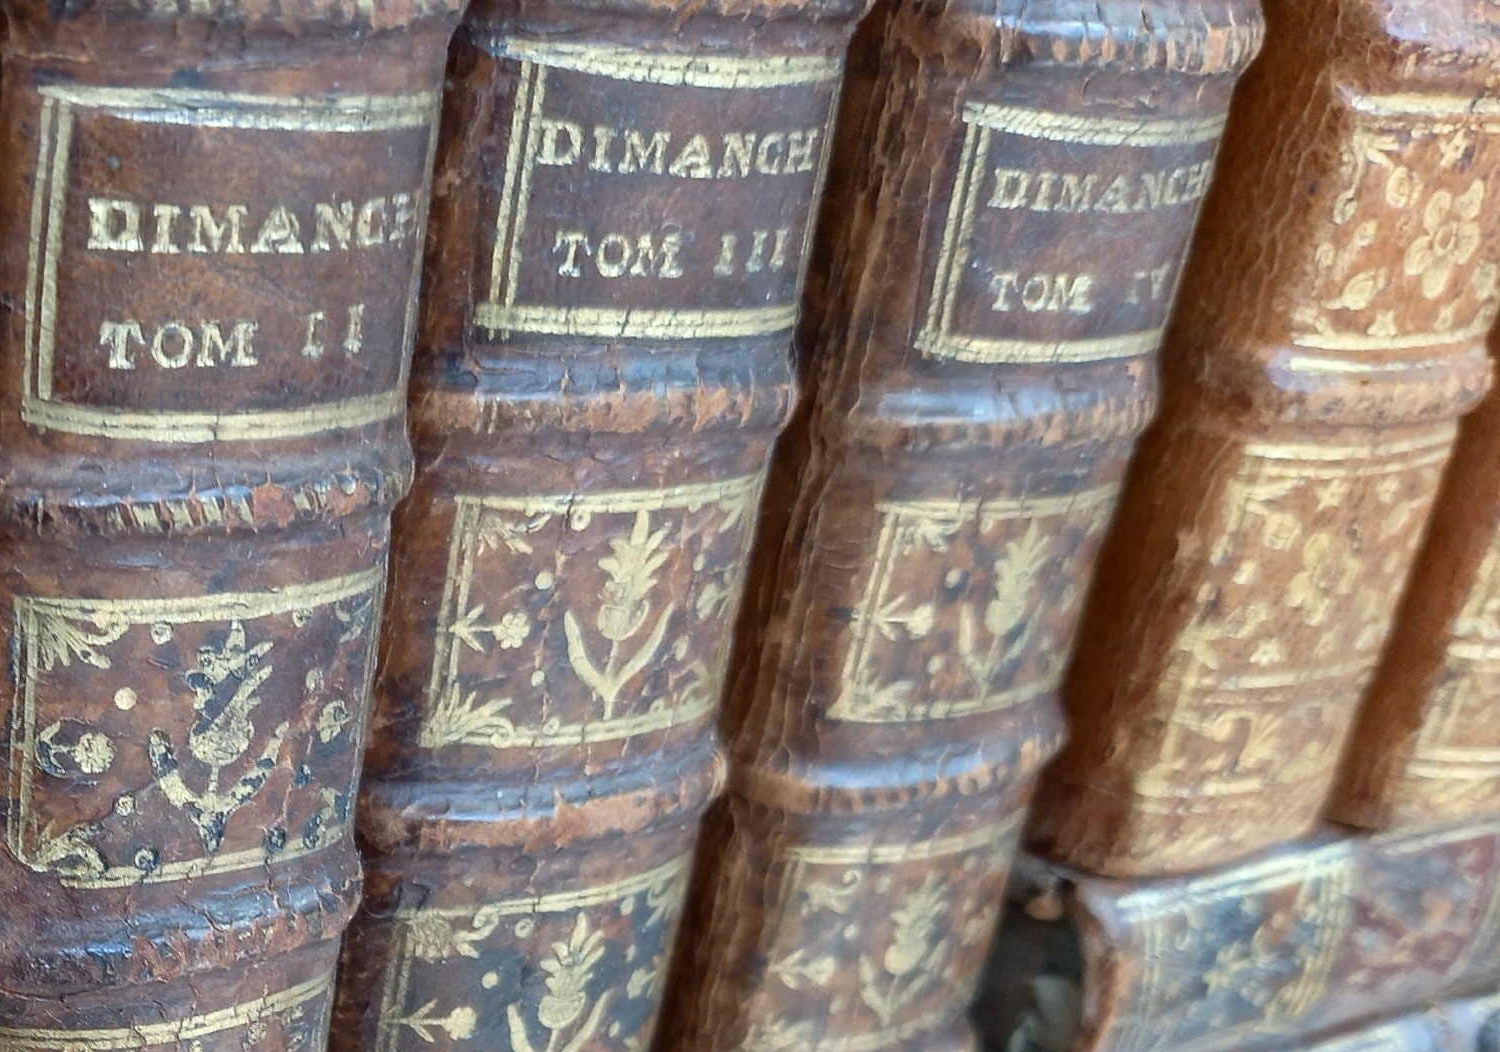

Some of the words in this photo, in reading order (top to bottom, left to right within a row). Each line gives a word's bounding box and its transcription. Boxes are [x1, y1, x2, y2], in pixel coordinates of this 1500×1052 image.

[536, 119, 818, 178] DIMANCH
[552, 230, 684, 279] TOM
[713, 225, 789, 277] III
[990, 272, 1094, 313] TOM
[100, 319, 259, 369] TOM
[302, 303, 366, 358] II
